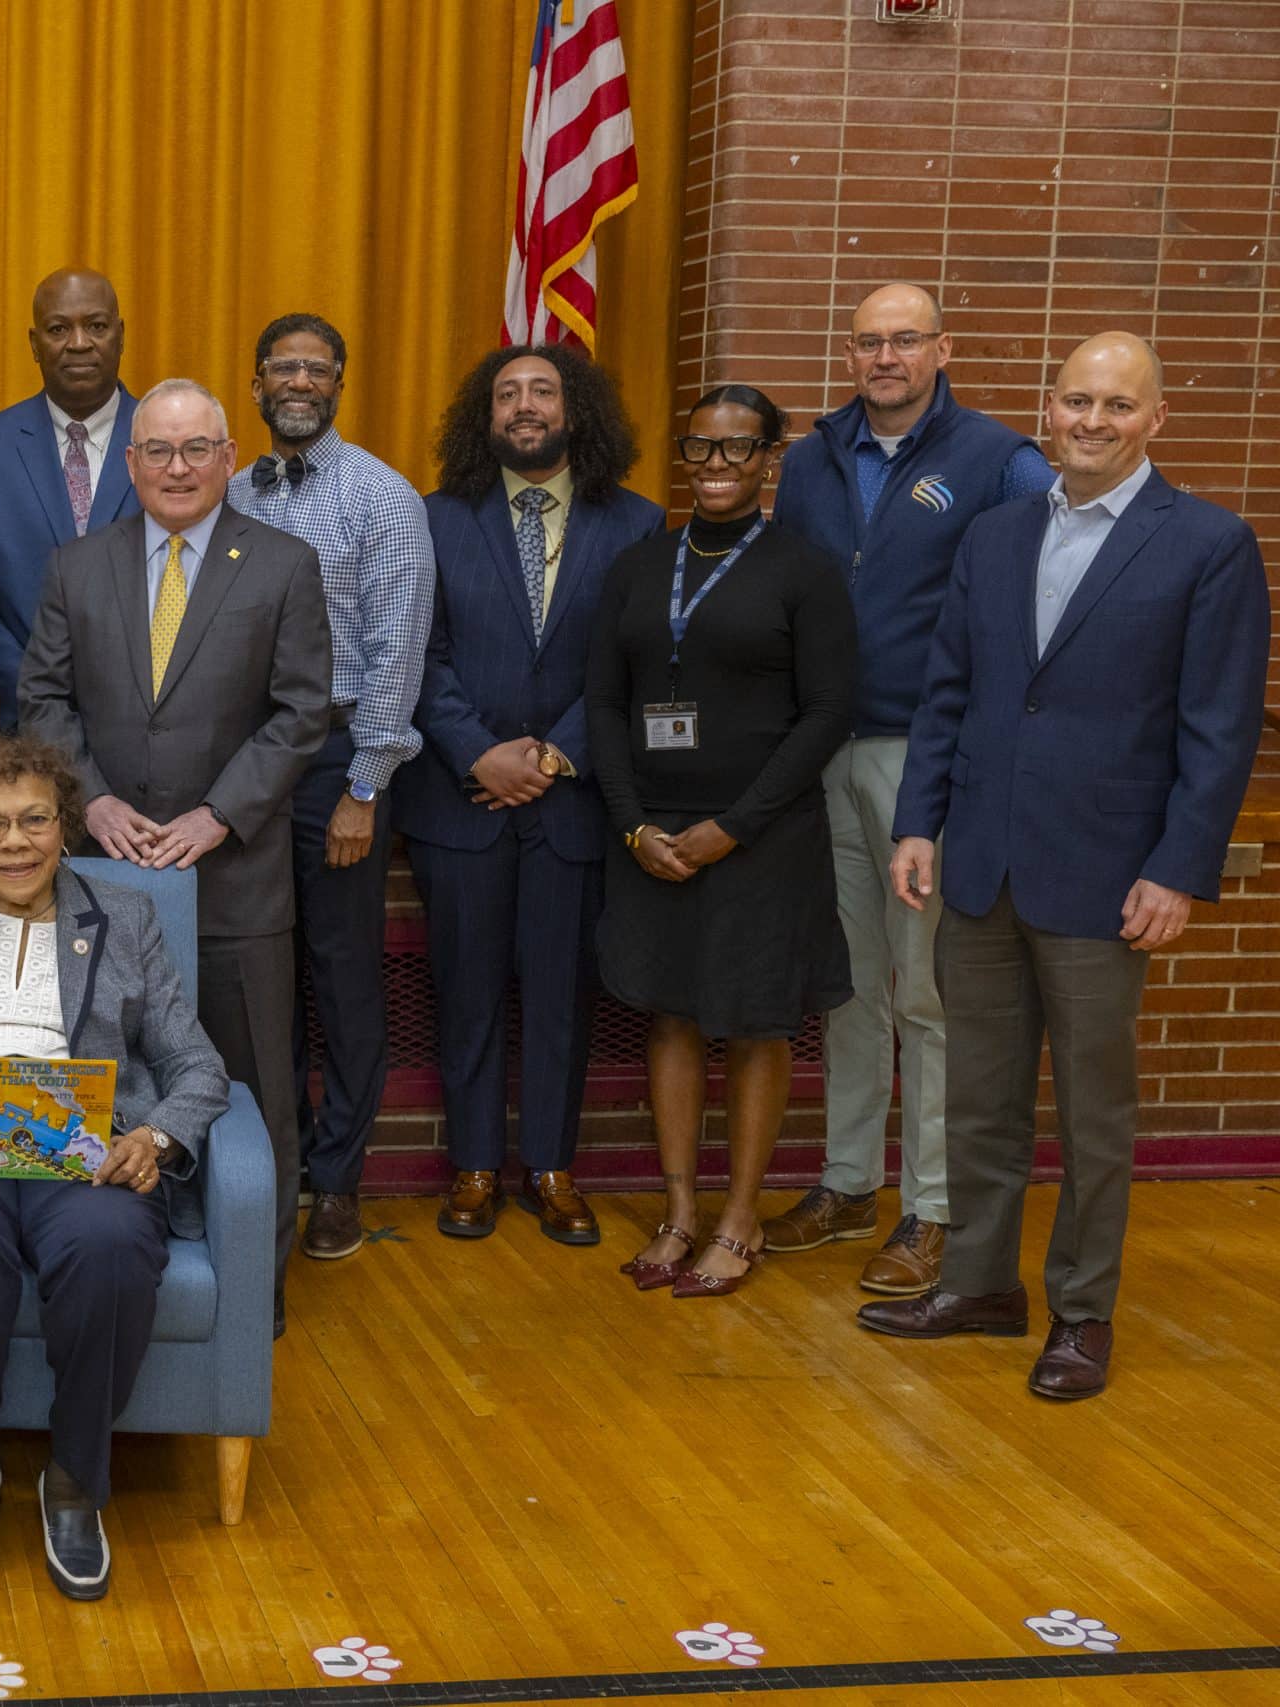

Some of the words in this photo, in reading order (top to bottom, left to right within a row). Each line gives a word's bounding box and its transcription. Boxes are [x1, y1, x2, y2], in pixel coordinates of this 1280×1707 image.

[8, 1062, 52, 1074] LITTLE
[58, 1063, 108, 1076] ENGINE
[0, 1075, 34, 1086] THAT
[37, 1076, 80, 1087] COULD
[1036, 1626, 1076, 1637] 5
[686, 1639, 719, 1651] 6
[323, 1655, 358, 1666] 7
